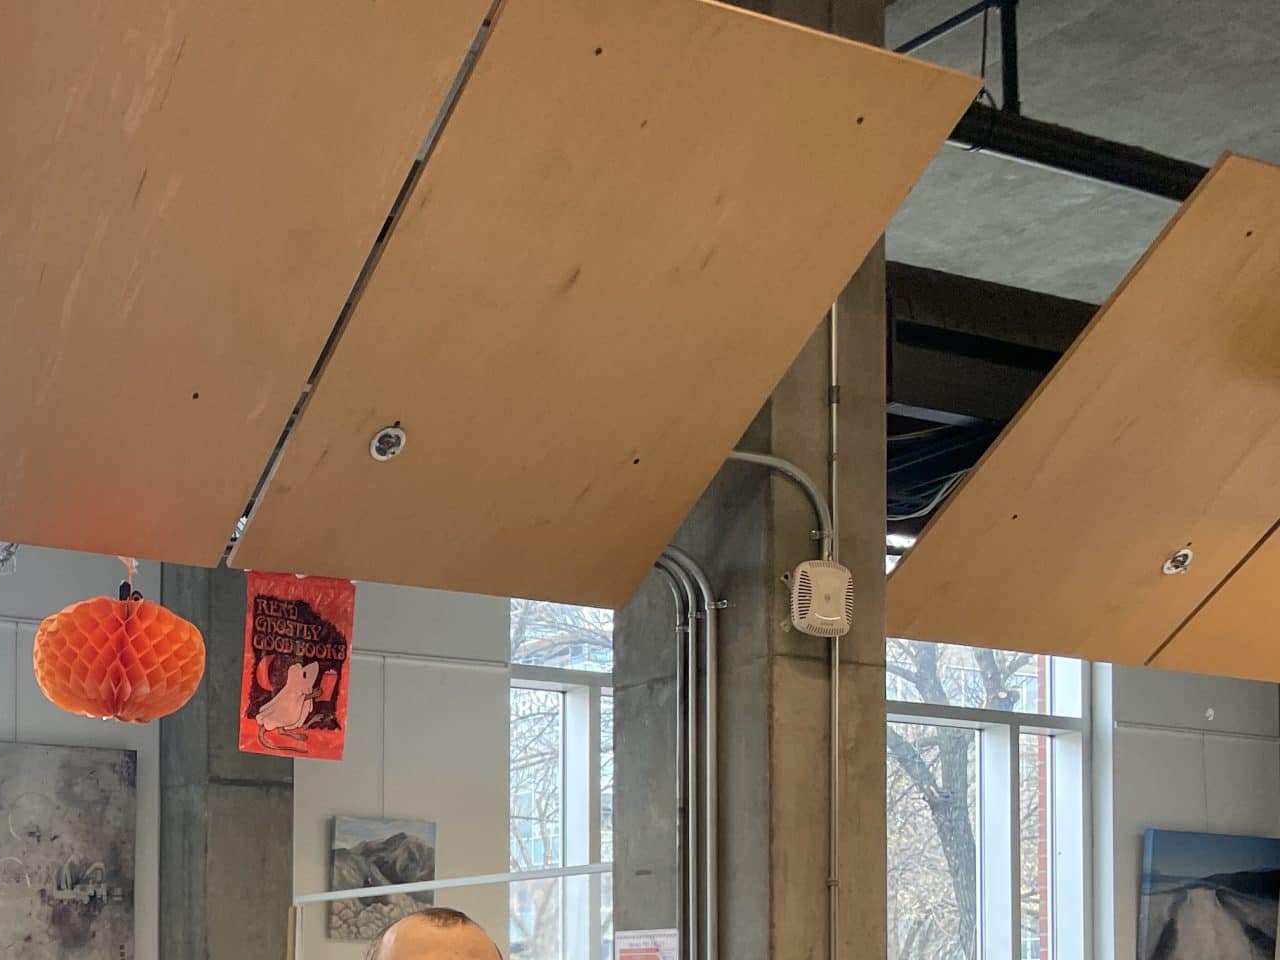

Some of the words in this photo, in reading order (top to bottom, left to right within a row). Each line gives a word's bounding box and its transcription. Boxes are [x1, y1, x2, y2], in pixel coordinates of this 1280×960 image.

[255, 599, 298, 619] READ
[255, 616, 322, 641] GHOSTLY
[254, 635, 294, 653] GOOD
[295, 641, 346, 661] BOOKS
